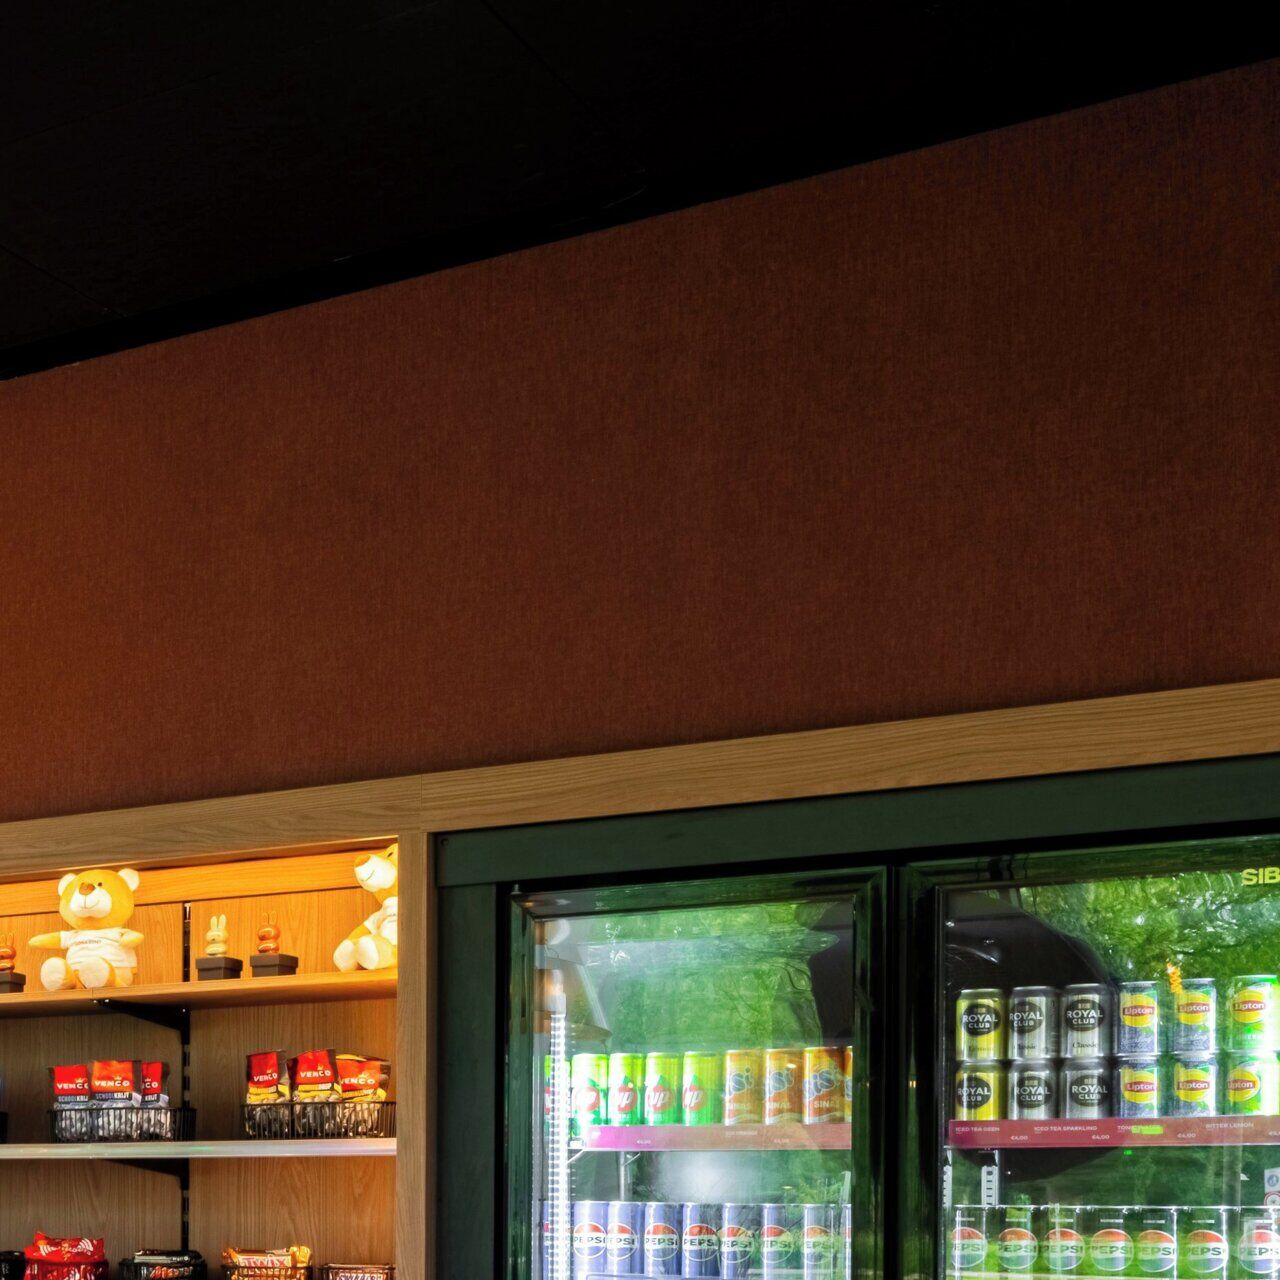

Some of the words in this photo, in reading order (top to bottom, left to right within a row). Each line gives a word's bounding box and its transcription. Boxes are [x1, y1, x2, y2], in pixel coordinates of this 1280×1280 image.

[1234, 1002, 1265, 1010] Lipton
[1067, 1010, 1103, 1018] ROYAL
[1124, 1007, 1153, 1015] Lipton
[962, 1014, 998, 1023] ROYAL
[1009, 1011, 1043, 1020] ROYAL
[253, 1073, 278, 1082] VENCO
[300, 1070, 331, 1078] VENCO
[1072, 1085, 1108, 1093] ROYAL
[1126, 1083, 1155, 1091] Lipton
[1179, 1081, 1209, 1089] Lipton
[958, 1087, 990, 1095] ROYAL
[1014, 1086, 1050, 1094] ROYAL
[645, 1238, 678, 1246] PEPSI
